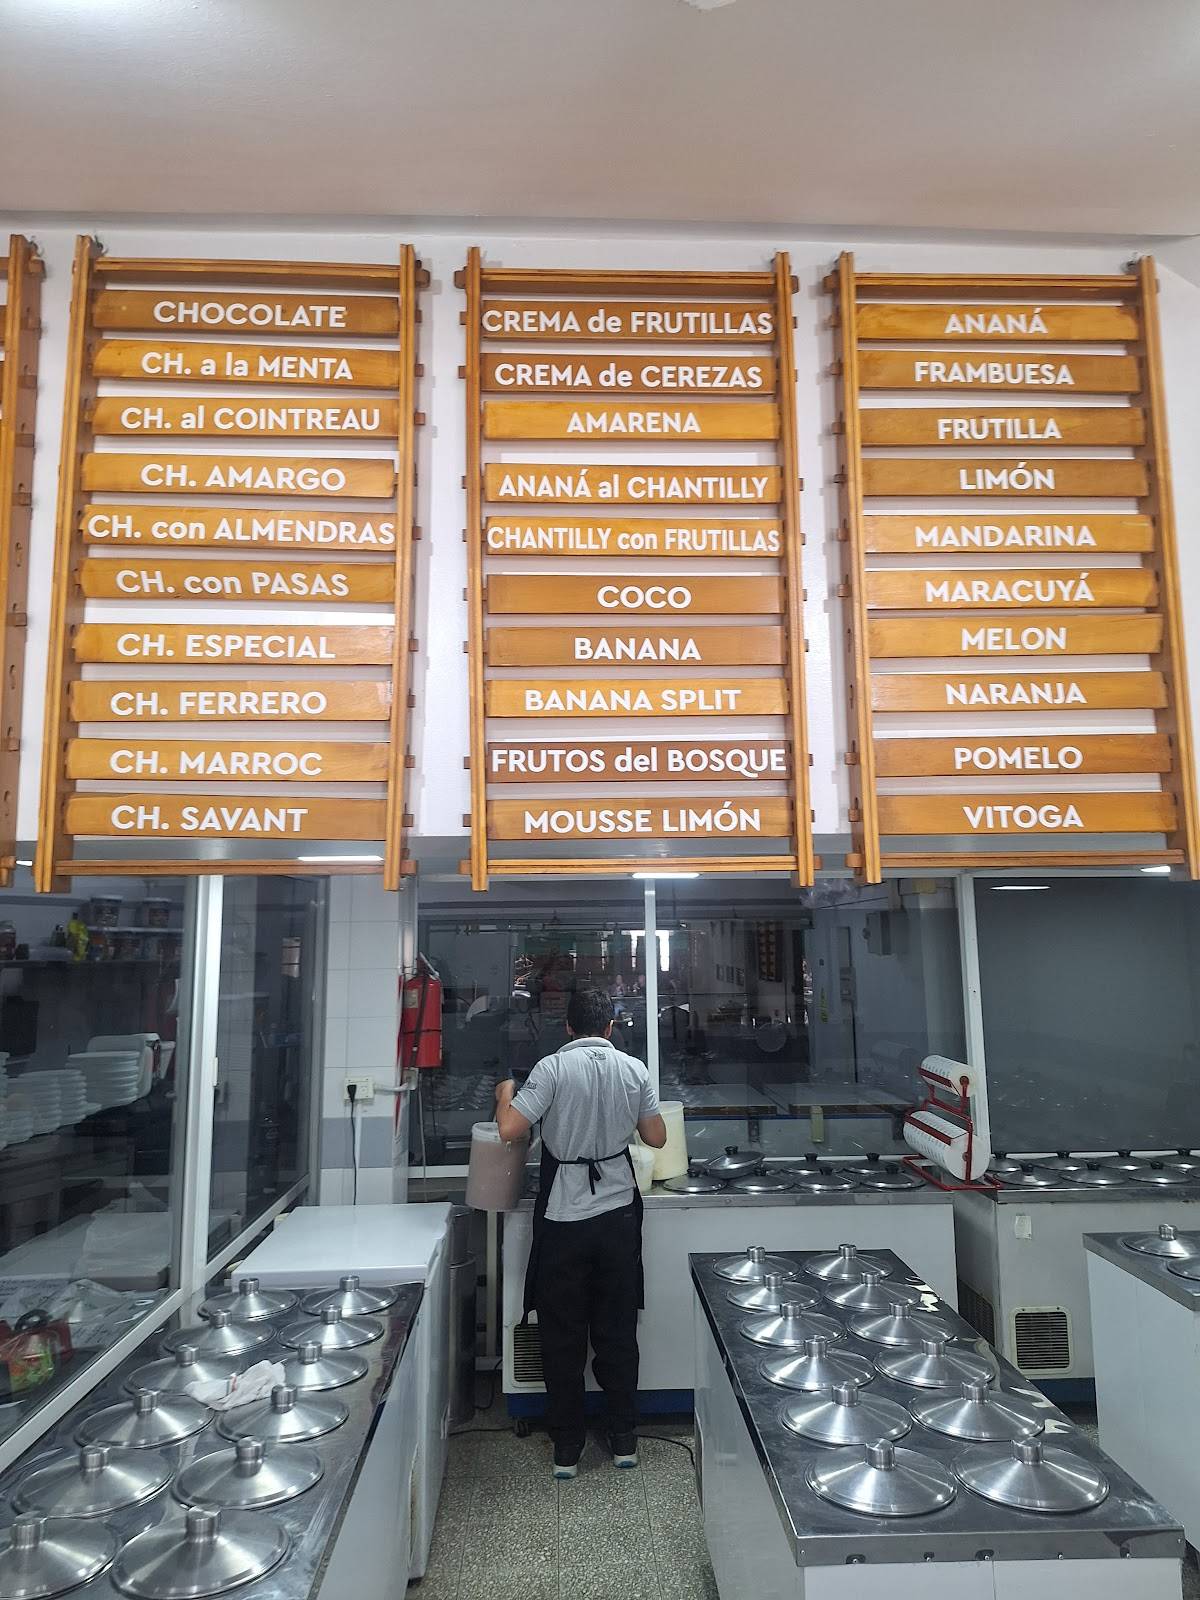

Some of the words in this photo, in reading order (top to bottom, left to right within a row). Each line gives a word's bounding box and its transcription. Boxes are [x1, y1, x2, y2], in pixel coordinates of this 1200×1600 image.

[153, 300, 346, 328] CHOCOLATE
[481, 310, 581, 333] CREMA
[587, 308, 622, 333] de
[630, 311, 773, 335] FRUTILLAS
[945, 307, 1047, 334] ANANÁ
[141, 351, 191, 375] CH.
[200, 358, 216, 376] a
[225, 351, 249, 377] la
[258, 356, 353, 380] MENTA
[494, 363, 592, 387] CREMA
[598, 362, 633, 388] de
[640, 365, 763, 389] CEREZAS
[914, 361, 1074, 385] FRAMBUESA
[120, 407, 171, 429] CH.
[180, 405, 205, 429] al
[213, 407, 380, 431] COINTREAU
[567, 411, 701, 433] AMARENA
[937, 418, 1062, 440] FRUTILLA
[140, 463, 197, 487] CH.
[205, 465, 346, 493] AMARGO
[498, 468, 592, 498] ANANÁ
[598, 474, 619, 499] al
[626, 476, 769, 499] CHANTILLY
[959, 461, 1055, 490] LIMÓN
[87, 514, 141, 538] CH.
[151, 521, 206, 540] con
[213, 518, 395, 545] ALMENDRAS
[486, 526, 611, 550] CHANTILLY
[617, 532, 658, 550] con
[664, 528, 780, 553] FRUTILLAS
[914, 525, 1096, 548] MANDARINA
[115, 570, 175, 593] CH.
[183, 575, 242, 594] con
[251, 571, 349, 597] PASAS
[597, 585, 692, 609] COCO
[924, 572, 1094, 603] MARACUYÁ
[117, 633, 174, 657] CH.
[185, 634, 336, 659] ESPECIAL
[574, 637, 702, 661] BANANA
[961, 626, 1067, 651] MELON
[110, 691, 169, 716] CH.
[179, 690, 328, 716] FERRERO
[524, 689, 653, 712] BANANA
[660, 688, 742, 711] SPLIT
[944, 682, 1087, 705] NARANJA
[109, 749, 168, 774] CH.
[178, 751, 322, 777] MARROC
[491, 749, 606, 773] FRUTOS
[613, 746, 658, 773] del
[667, 746, 787, 779] BOSQUE
[953, 746, 1083, 770] POMELO
[111, 805, 169, 830] CH.
[180, 806, 308, 832] SAVANT
[524, 809, 653, 834] MOUSSE
[662, 800, 761, 832] LIMÓN
[963, 804, 1084, 829] VITOGA
